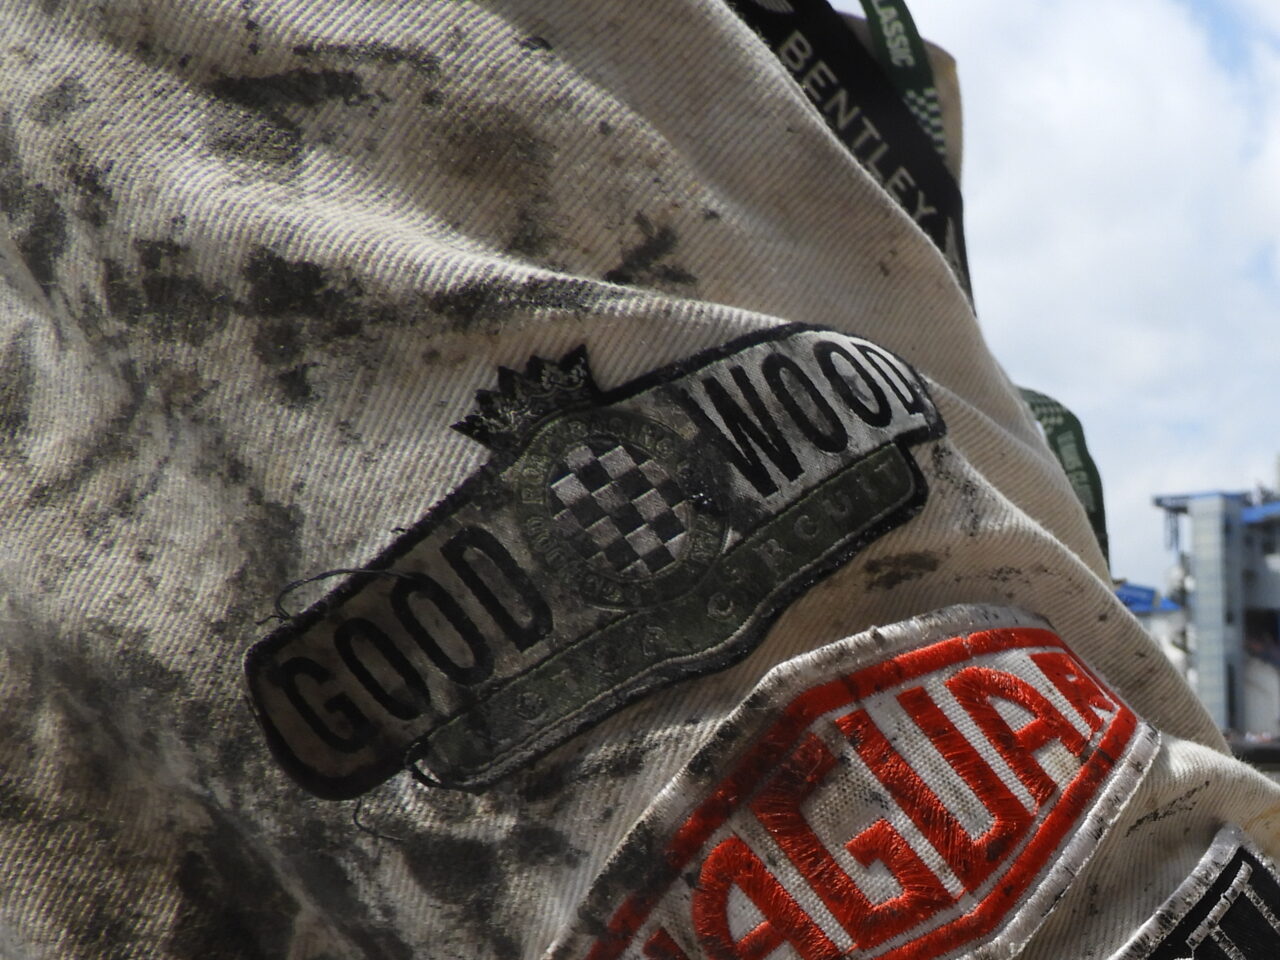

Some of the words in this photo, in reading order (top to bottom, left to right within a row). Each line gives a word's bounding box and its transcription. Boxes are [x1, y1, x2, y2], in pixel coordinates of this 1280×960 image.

[777, 30, 937, 221] BENTLEY
[279, 525, 554, 753] GOOD
[674, 340, 924, 497] WOOD
